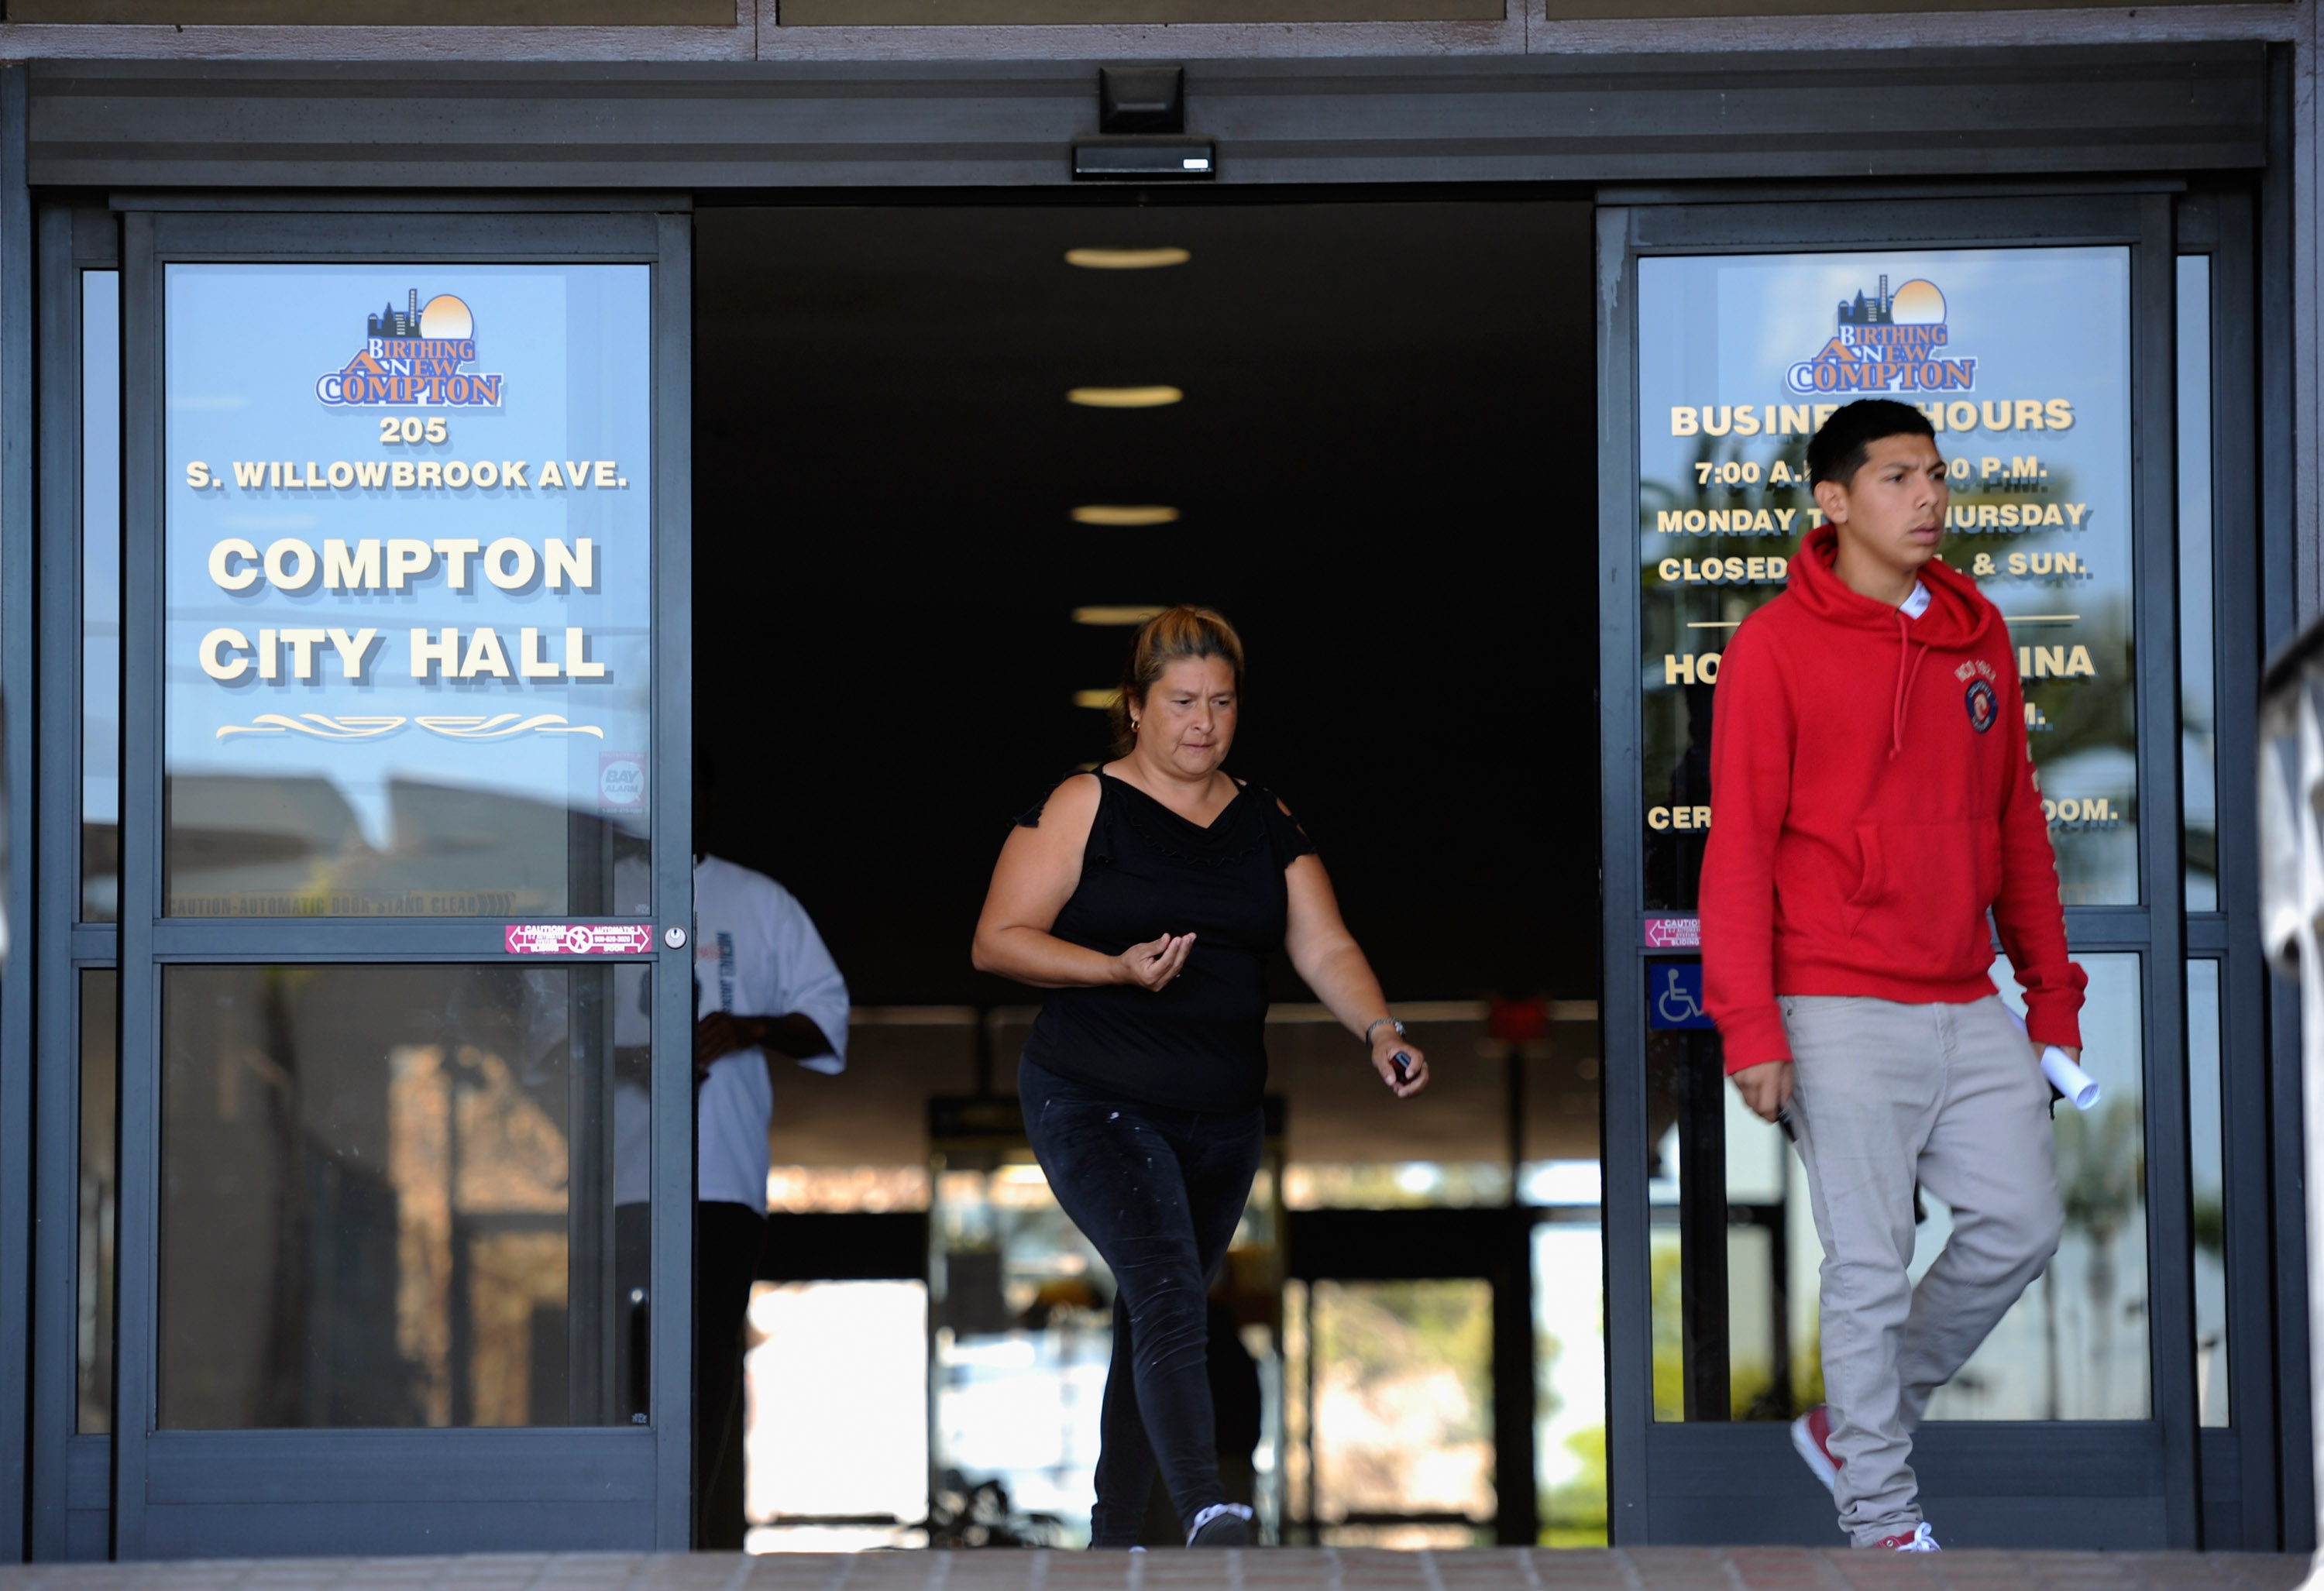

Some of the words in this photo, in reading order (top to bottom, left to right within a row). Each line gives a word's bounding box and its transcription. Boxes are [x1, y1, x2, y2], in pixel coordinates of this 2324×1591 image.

[1841, 325, 1947, 345] BIRTHING
[368, 338, 474, 359] BIRTHING
[1813, 338, 1859, 363] A
[1862, 344, 1929, 363] NEW
[342, 350, 387, 375] A
[389, 358, 459, 376] NEW
[1788, 360, 1973, 391] COMPTON
[317, 375, 499, 404] COMPTON
[380, 417, 447, 443] 205
[1671, 404, 1838, 436] BUSINE
[1916, 398, 2073, 431] HOURS
[186, 461, 222, 487] S.
[233, 461, 528, 487] WILLOWBROOK
[538, 460, 628, 486] AVE.
[1695, 461, 1761, 484] 7:00
[1769, 459, 1812, 483] A.
[1981, 455, 2048, 479] P.M.
[1658, 508, 1796, 533] MONDAY
[1945, 503, 2086, 527] URSDAY
[208, 537, 593, 590] COMPTON
[1659, 556, 1788, 581] CLOSED
[1972, 552, 1996, 576] &
[2008, 552, 2086, 575] SUN.
[198, 627, 378, 680] CITY
[410, 627, 606, 677] HALL
[604, 784, 639, 793] ALARM
[605, 769, 640, 784] BAY
[431, 895, 476, 913] CLEAR
[593, 926, 635, 935] AUTOMATIC
